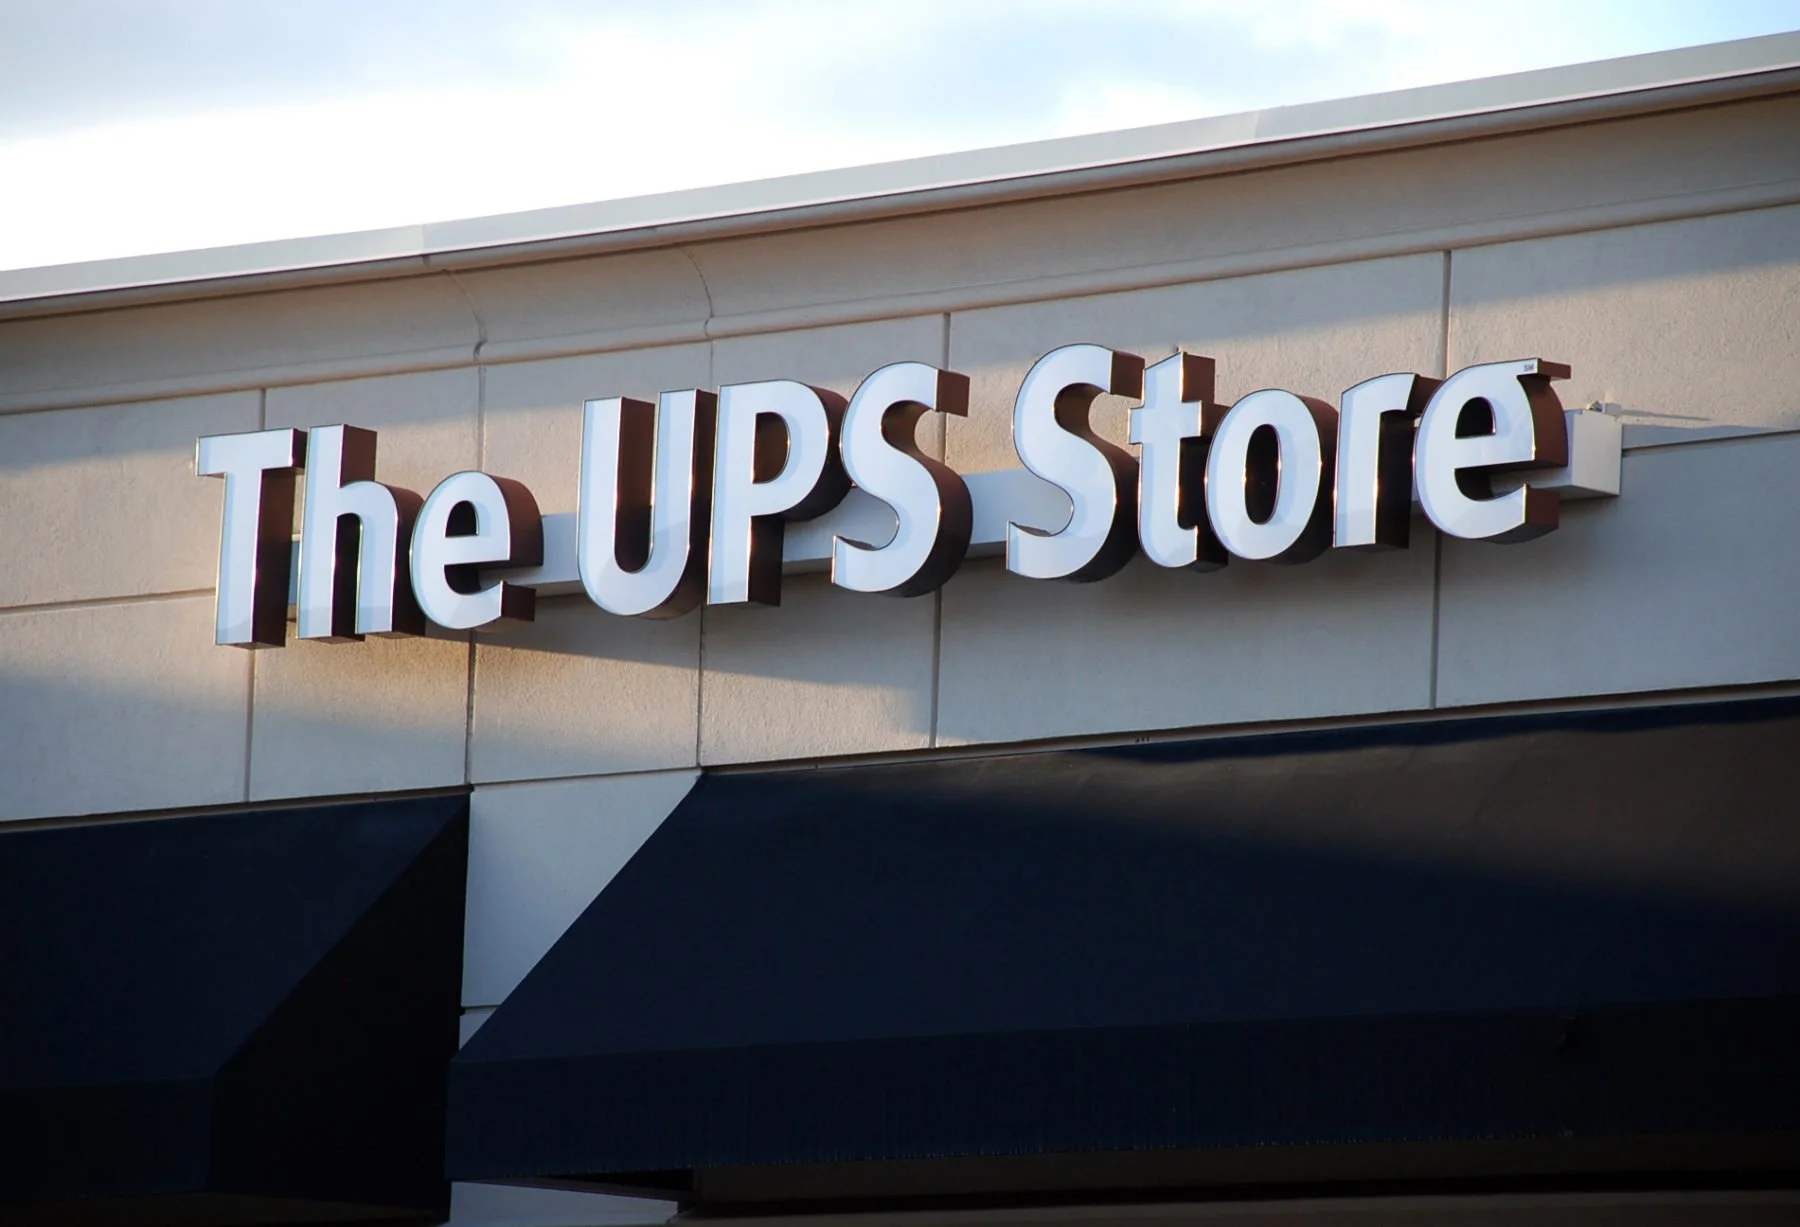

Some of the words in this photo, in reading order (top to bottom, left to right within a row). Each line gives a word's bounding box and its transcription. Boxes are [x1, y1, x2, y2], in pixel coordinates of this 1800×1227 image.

[196, 424, 515, 646] The
[577, 361, 945, 616] UPS
[1006, 343, 1542, 579] Store
